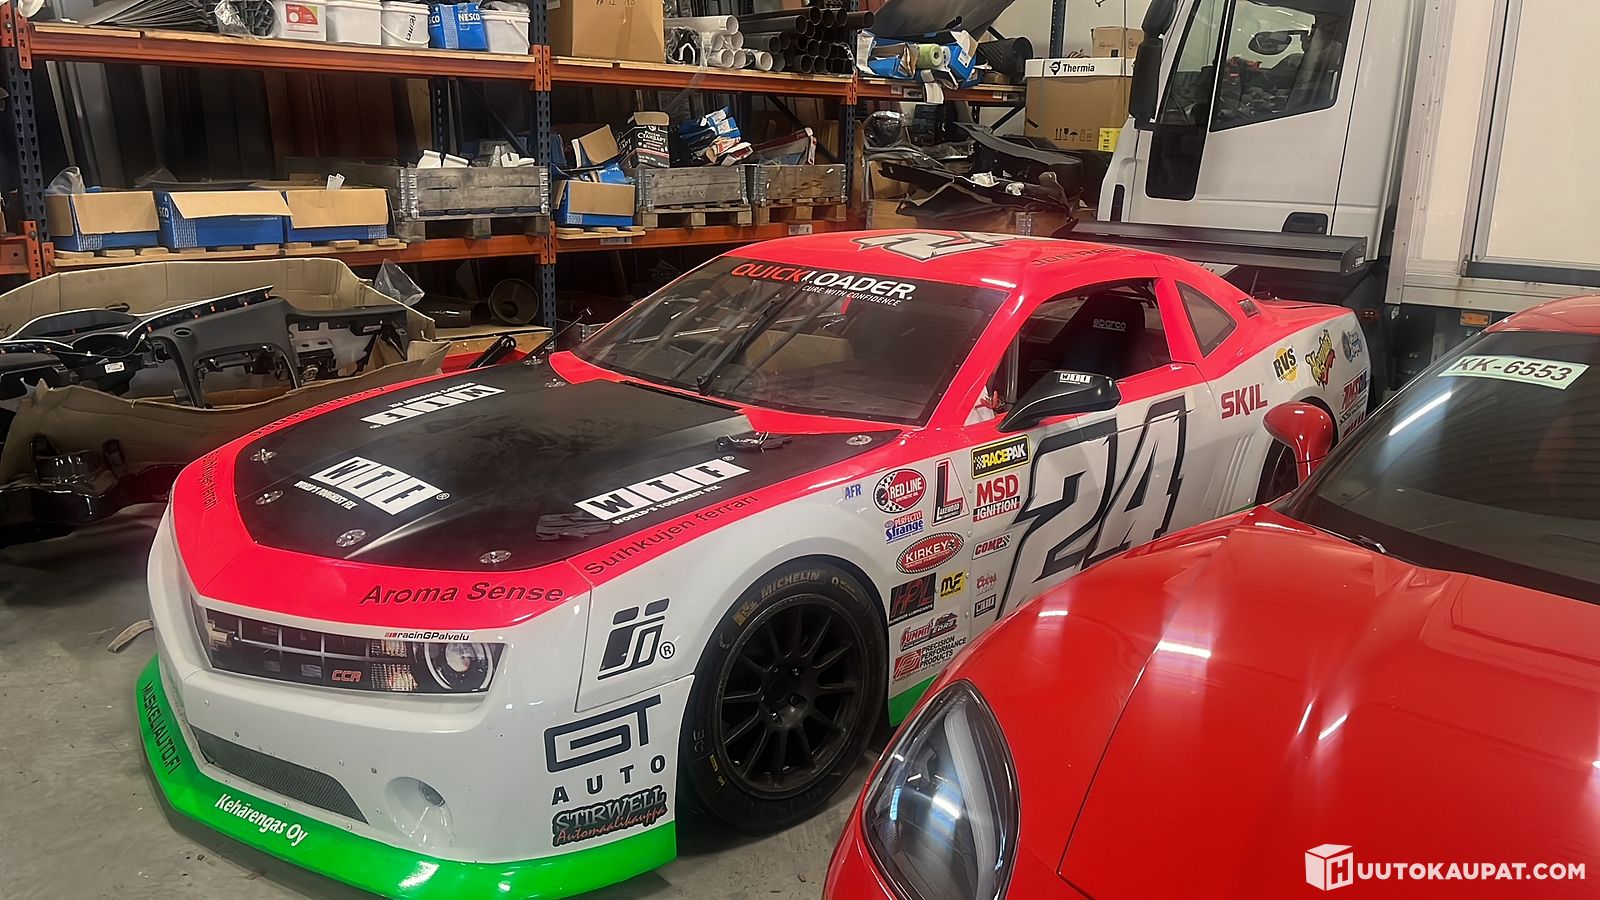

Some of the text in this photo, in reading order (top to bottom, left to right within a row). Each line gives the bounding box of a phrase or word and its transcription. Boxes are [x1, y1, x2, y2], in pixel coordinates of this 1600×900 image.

[1063, 63, 1095, 73] Thermia
[802, 285, 902, 307] CURE WITH CONFIDENCE
[1272, 348, 1297, 379] RVS
[1451, 358, 1573, 381] KK-6553
[1220, 383, 1268, 420] SKIL
[981, 443, 1027, 468] RACEPAK
[317, 457, 434, 510] WTF
[582, 461, 736, 517] WTF
[844, 484, 862, 500] AFR
[890, 478, 923, 500] RED LINE
[976, 474, 1019, 507] MSD
[341, 499, 359, 510] FIX
[611, 485, 722, 525] WORLD'S TOUGHEST FIX
[976, 498, 1018, 521] IGNITION
[1000, 394, 1187, 618] 24
[886, 520, 924, 541] Strange
[584, 520, 697, 576] Suihkujen
[905, 540, 949, 563] KIRKEY
[359, 582, 564, 605] Aroma Sense
[761, 571, 820, 599] MICHELIN
[396, 631, 470, 642] racinGPalvelu
[920, 637, 967, 660] PERFORMANCE
[921, 635, 955, 653] PRECISION
[920, 649, 954, 669] PRODUCTS
[331, 669, 362, 683] CCR
[543, 694, 662, 773] GT
[551, 754, 666, 806] AUTO
[214, 793, 309, 847] Kehärengas Oy
[555, 786, 665, 832] STIRWELL
[556, 806, 666, 844] Automaalikauppa
